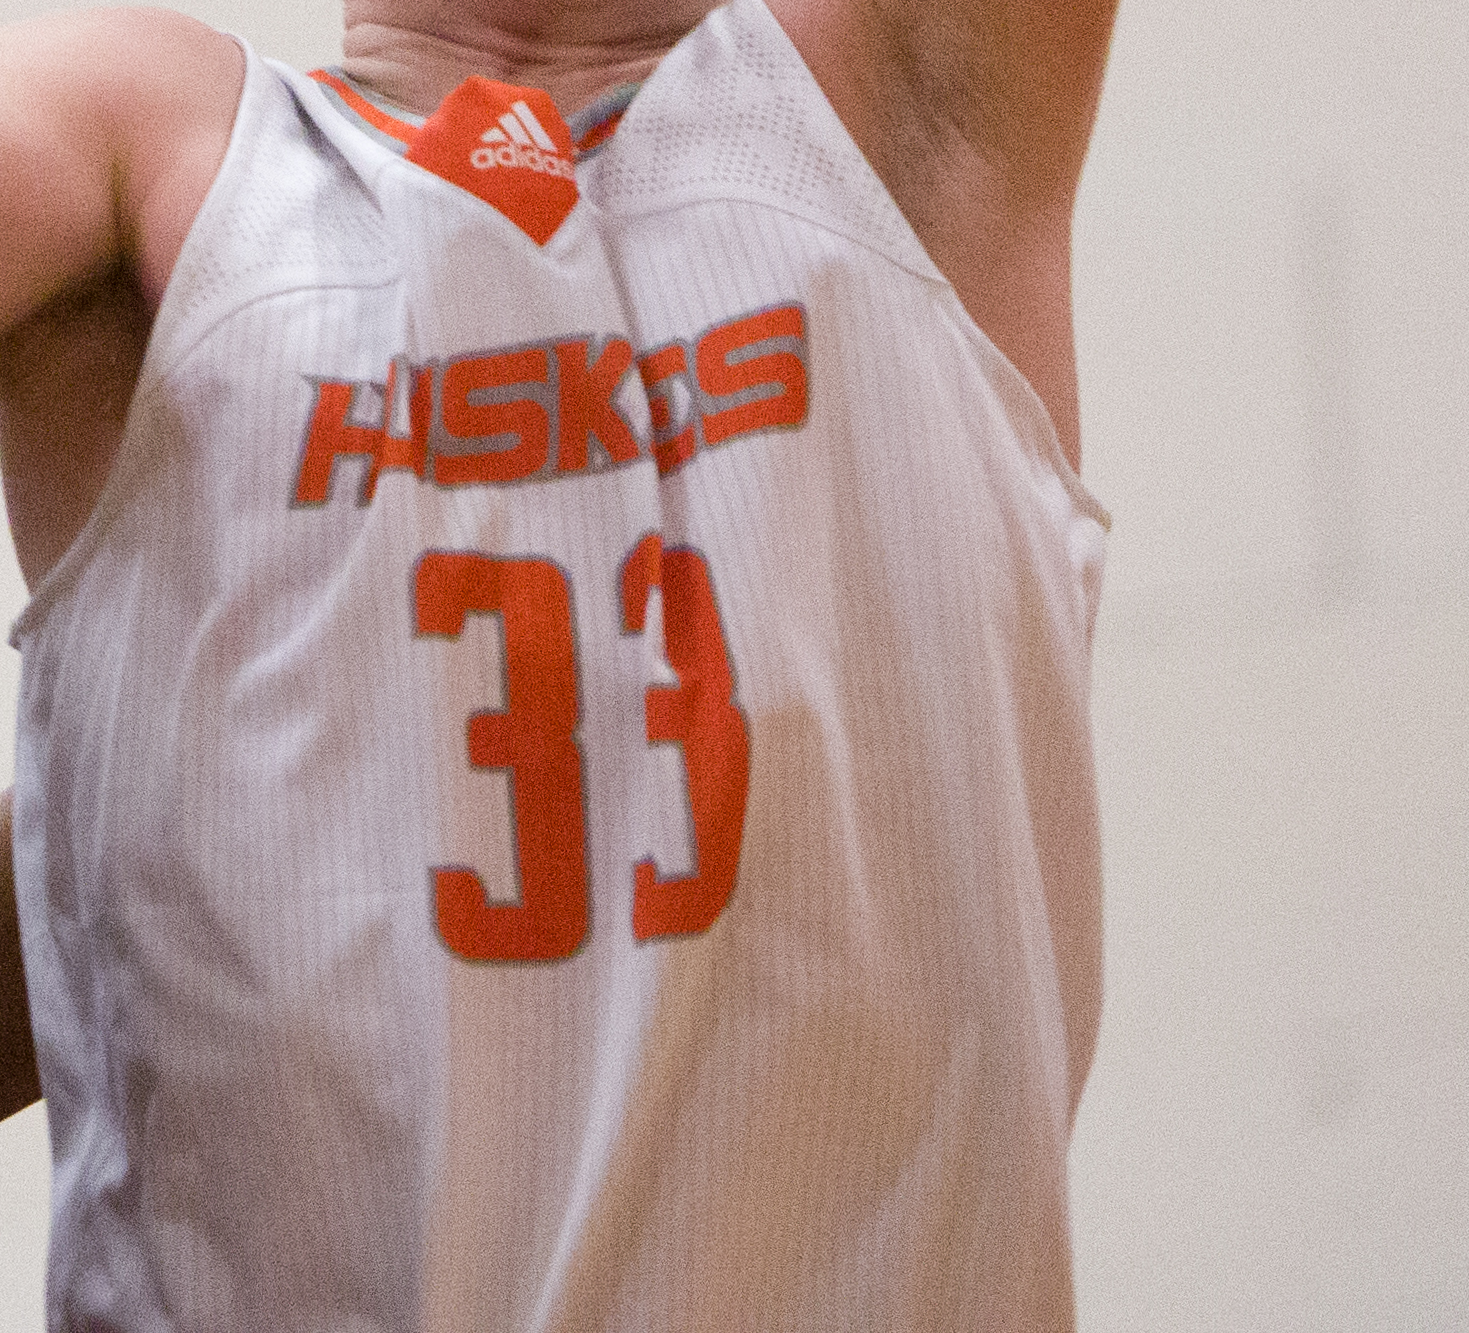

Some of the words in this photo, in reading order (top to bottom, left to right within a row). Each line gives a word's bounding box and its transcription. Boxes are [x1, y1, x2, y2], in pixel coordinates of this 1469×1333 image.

[470, 142, 574, 180] adidas
[288, 300, 808, 508] HUSKES
[413, 532, 750, 962] 33
